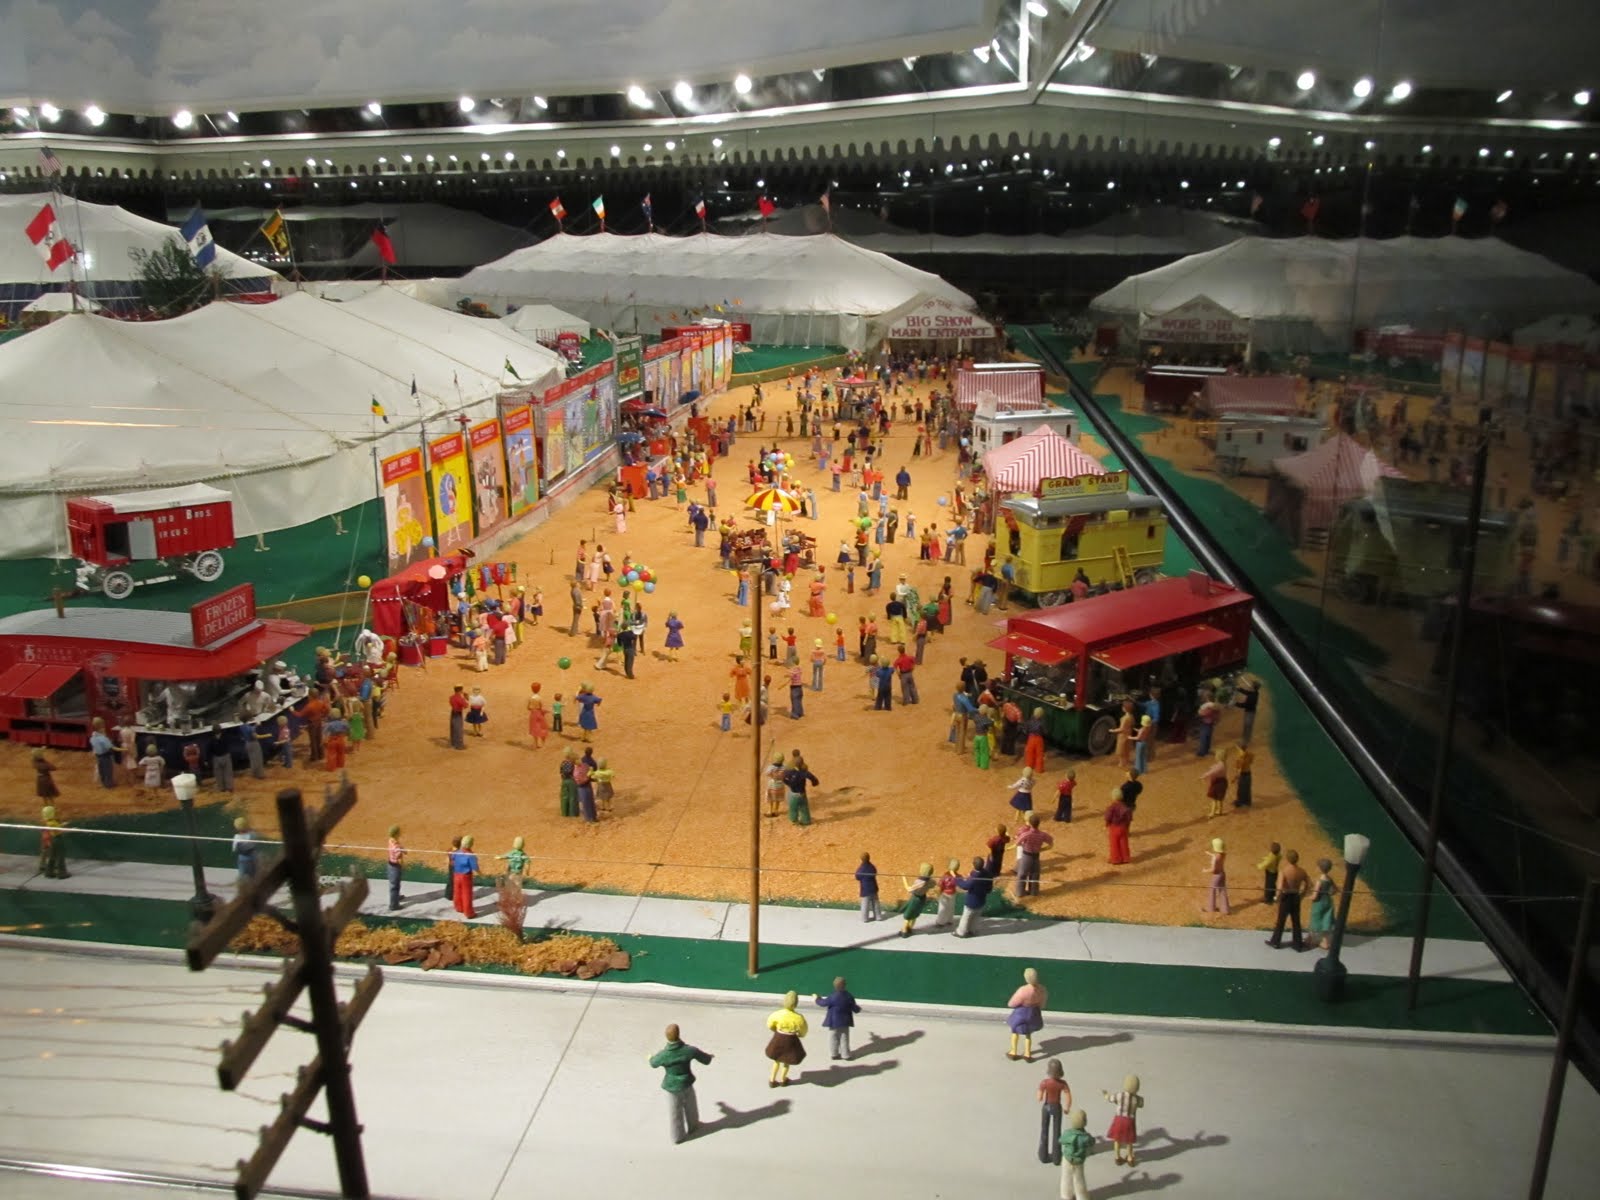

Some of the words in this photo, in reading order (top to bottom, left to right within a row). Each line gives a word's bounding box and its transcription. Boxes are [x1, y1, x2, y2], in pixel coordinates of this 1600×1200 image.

[906, 316, 931, 327] BIG
[935, 316, 973, 327] SHOW
[892, 328, 921, 337] MAIN
[928, 327, 991, 337] ENTRANCE
[1048, 480, 1081, 489] GRAND
[1088, 475, 1120, 485] STAND
[159, 528, 189, 539] IRCUS
[205, 593, 247, 621] FROZEN
[204, 605, 248, 637] DELIGHT
